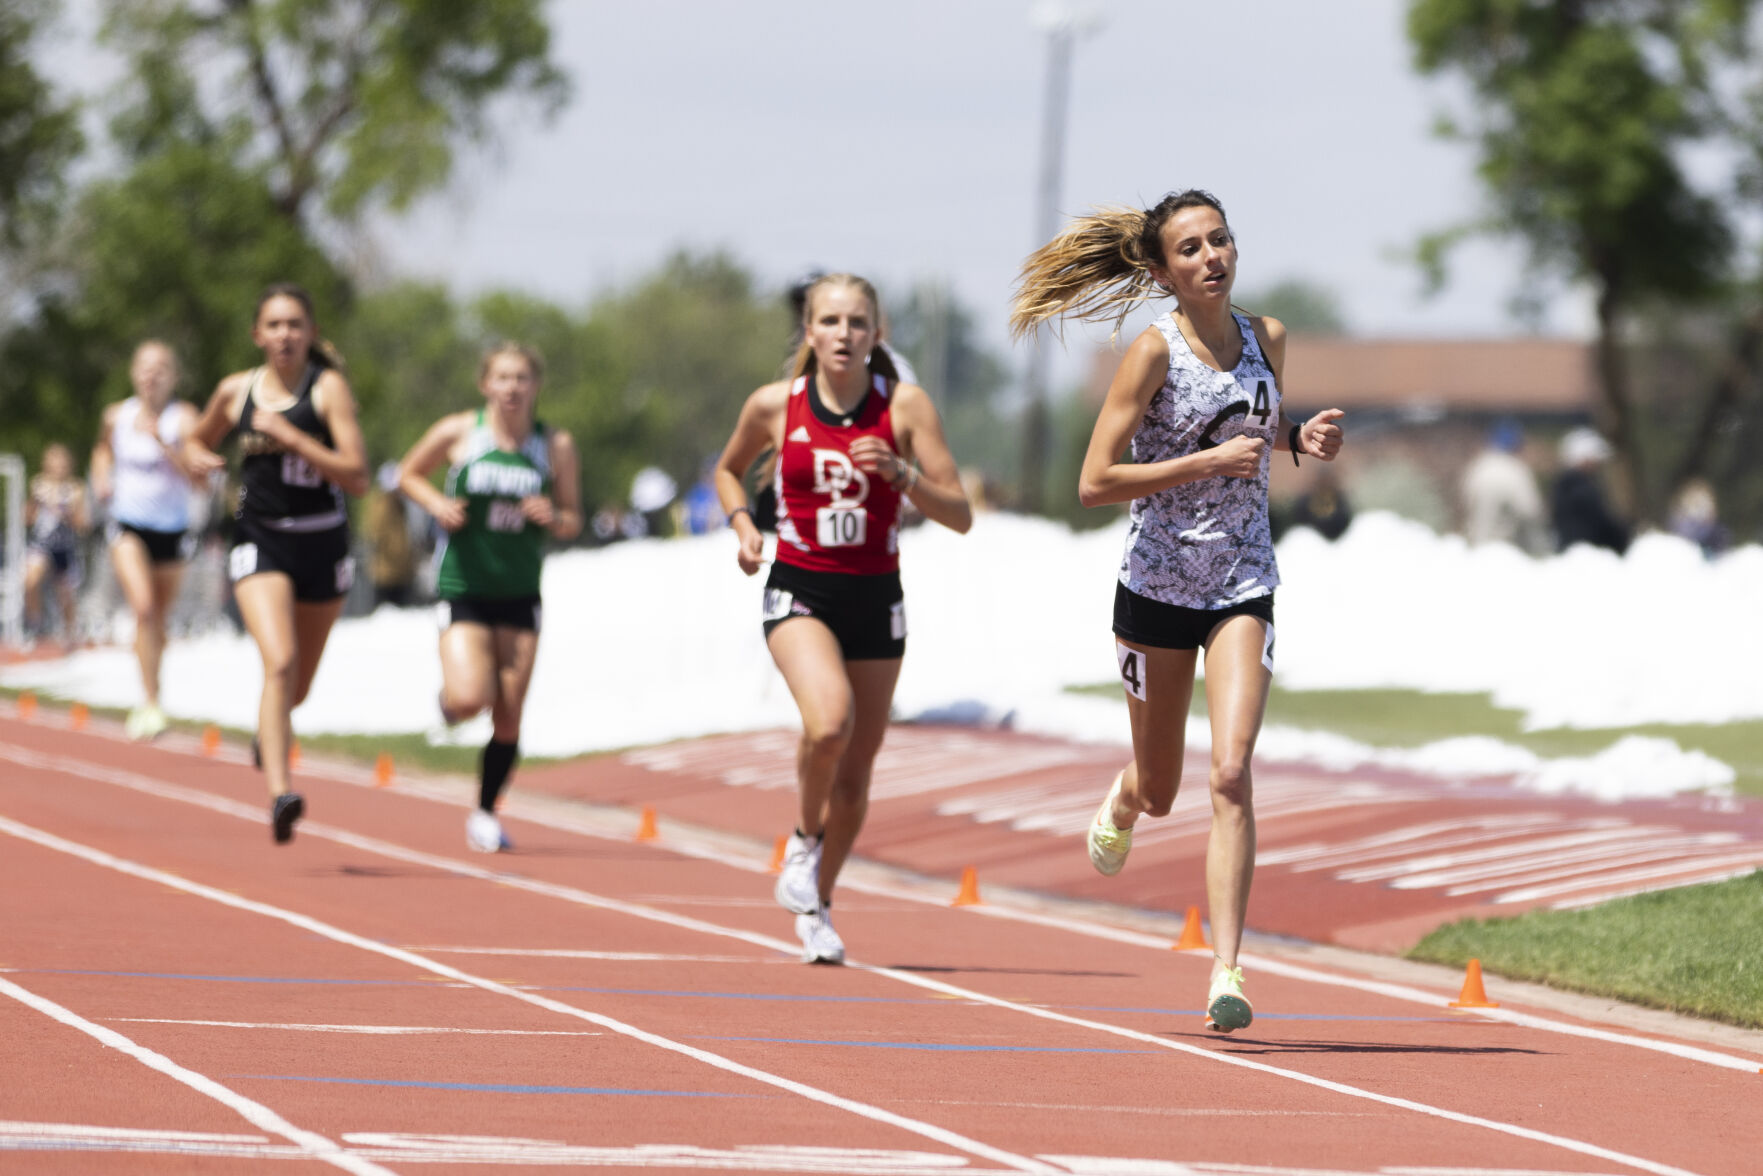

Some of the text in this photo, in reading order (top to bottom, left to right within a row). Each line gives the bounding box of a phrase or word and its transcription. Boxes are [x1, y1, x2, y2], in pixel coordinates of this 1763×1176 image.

[1252, 380, 1272, 426] 4
[828, 512, 857, 544] 10
[1121, 651, 1141, 695] 4
